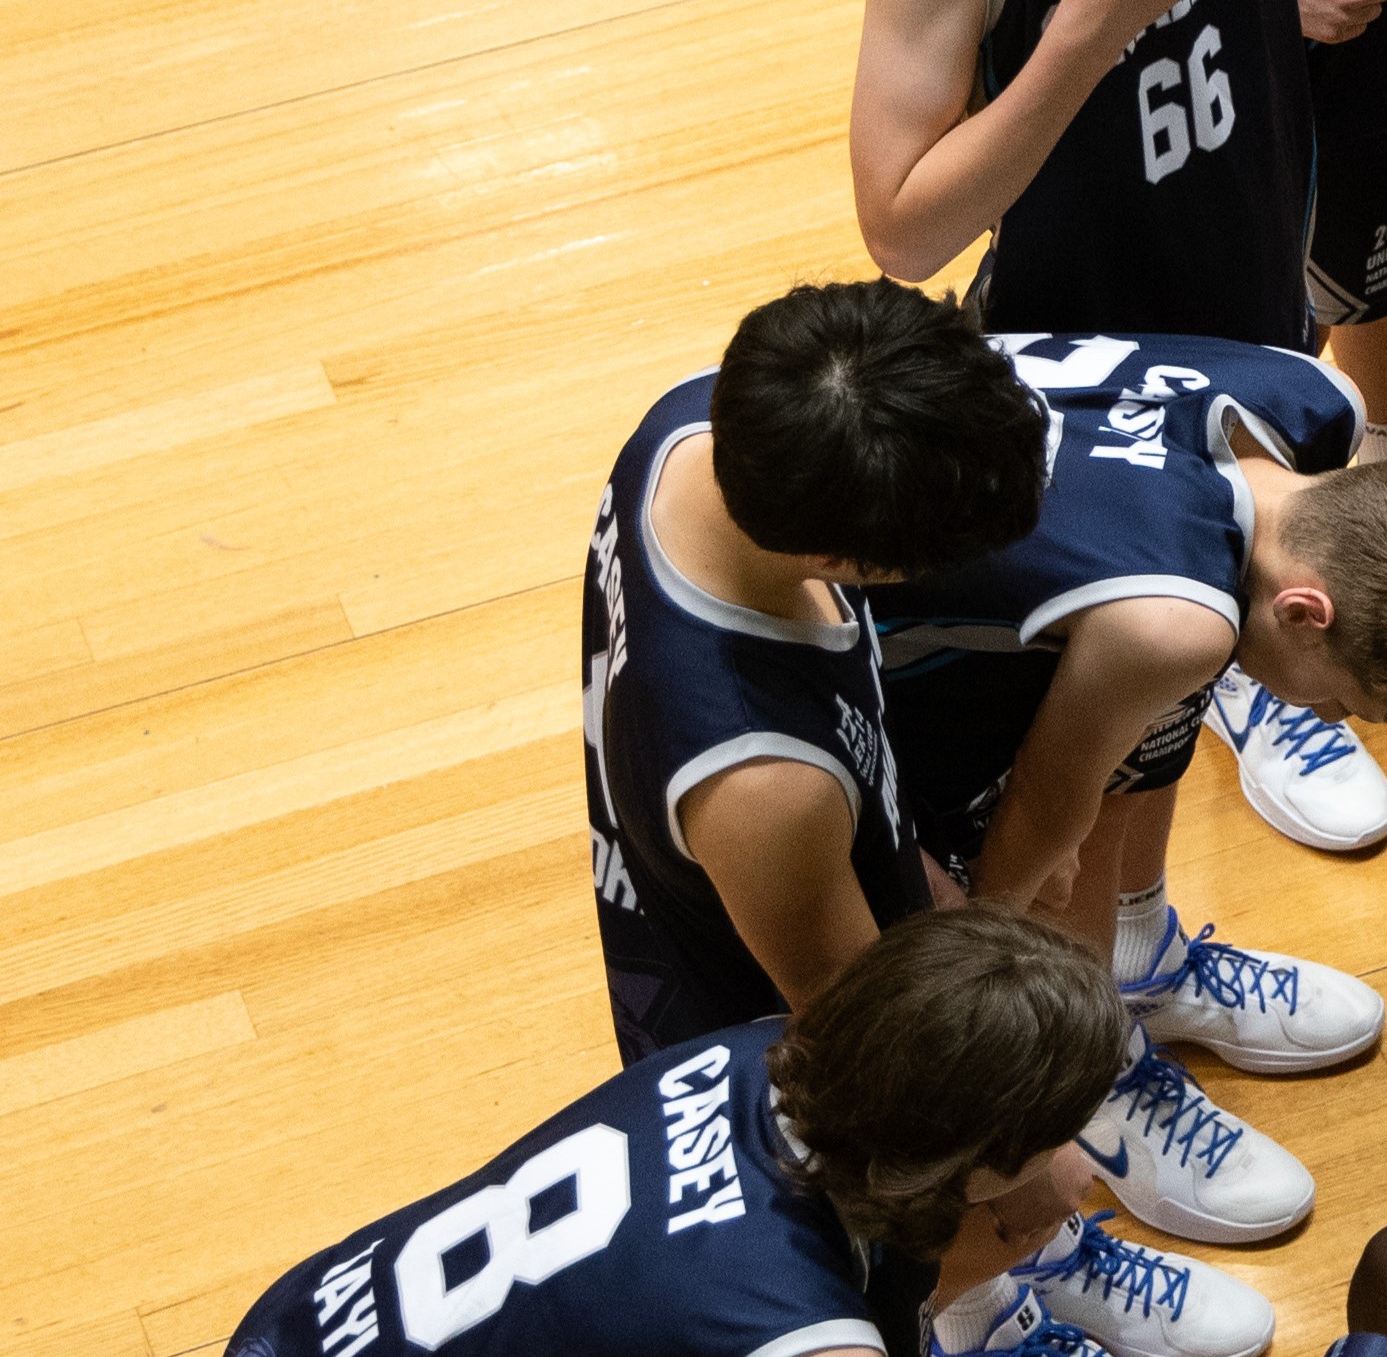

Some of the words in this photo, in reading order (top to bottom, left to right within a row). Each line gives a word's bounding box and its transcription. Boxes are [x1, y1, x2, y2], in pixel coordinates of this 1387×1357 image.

[1137, 24, 1236, 185] 66
[659, 1044, 746, 1235] CASEY
[394, 1122, 632, 1352] 8
